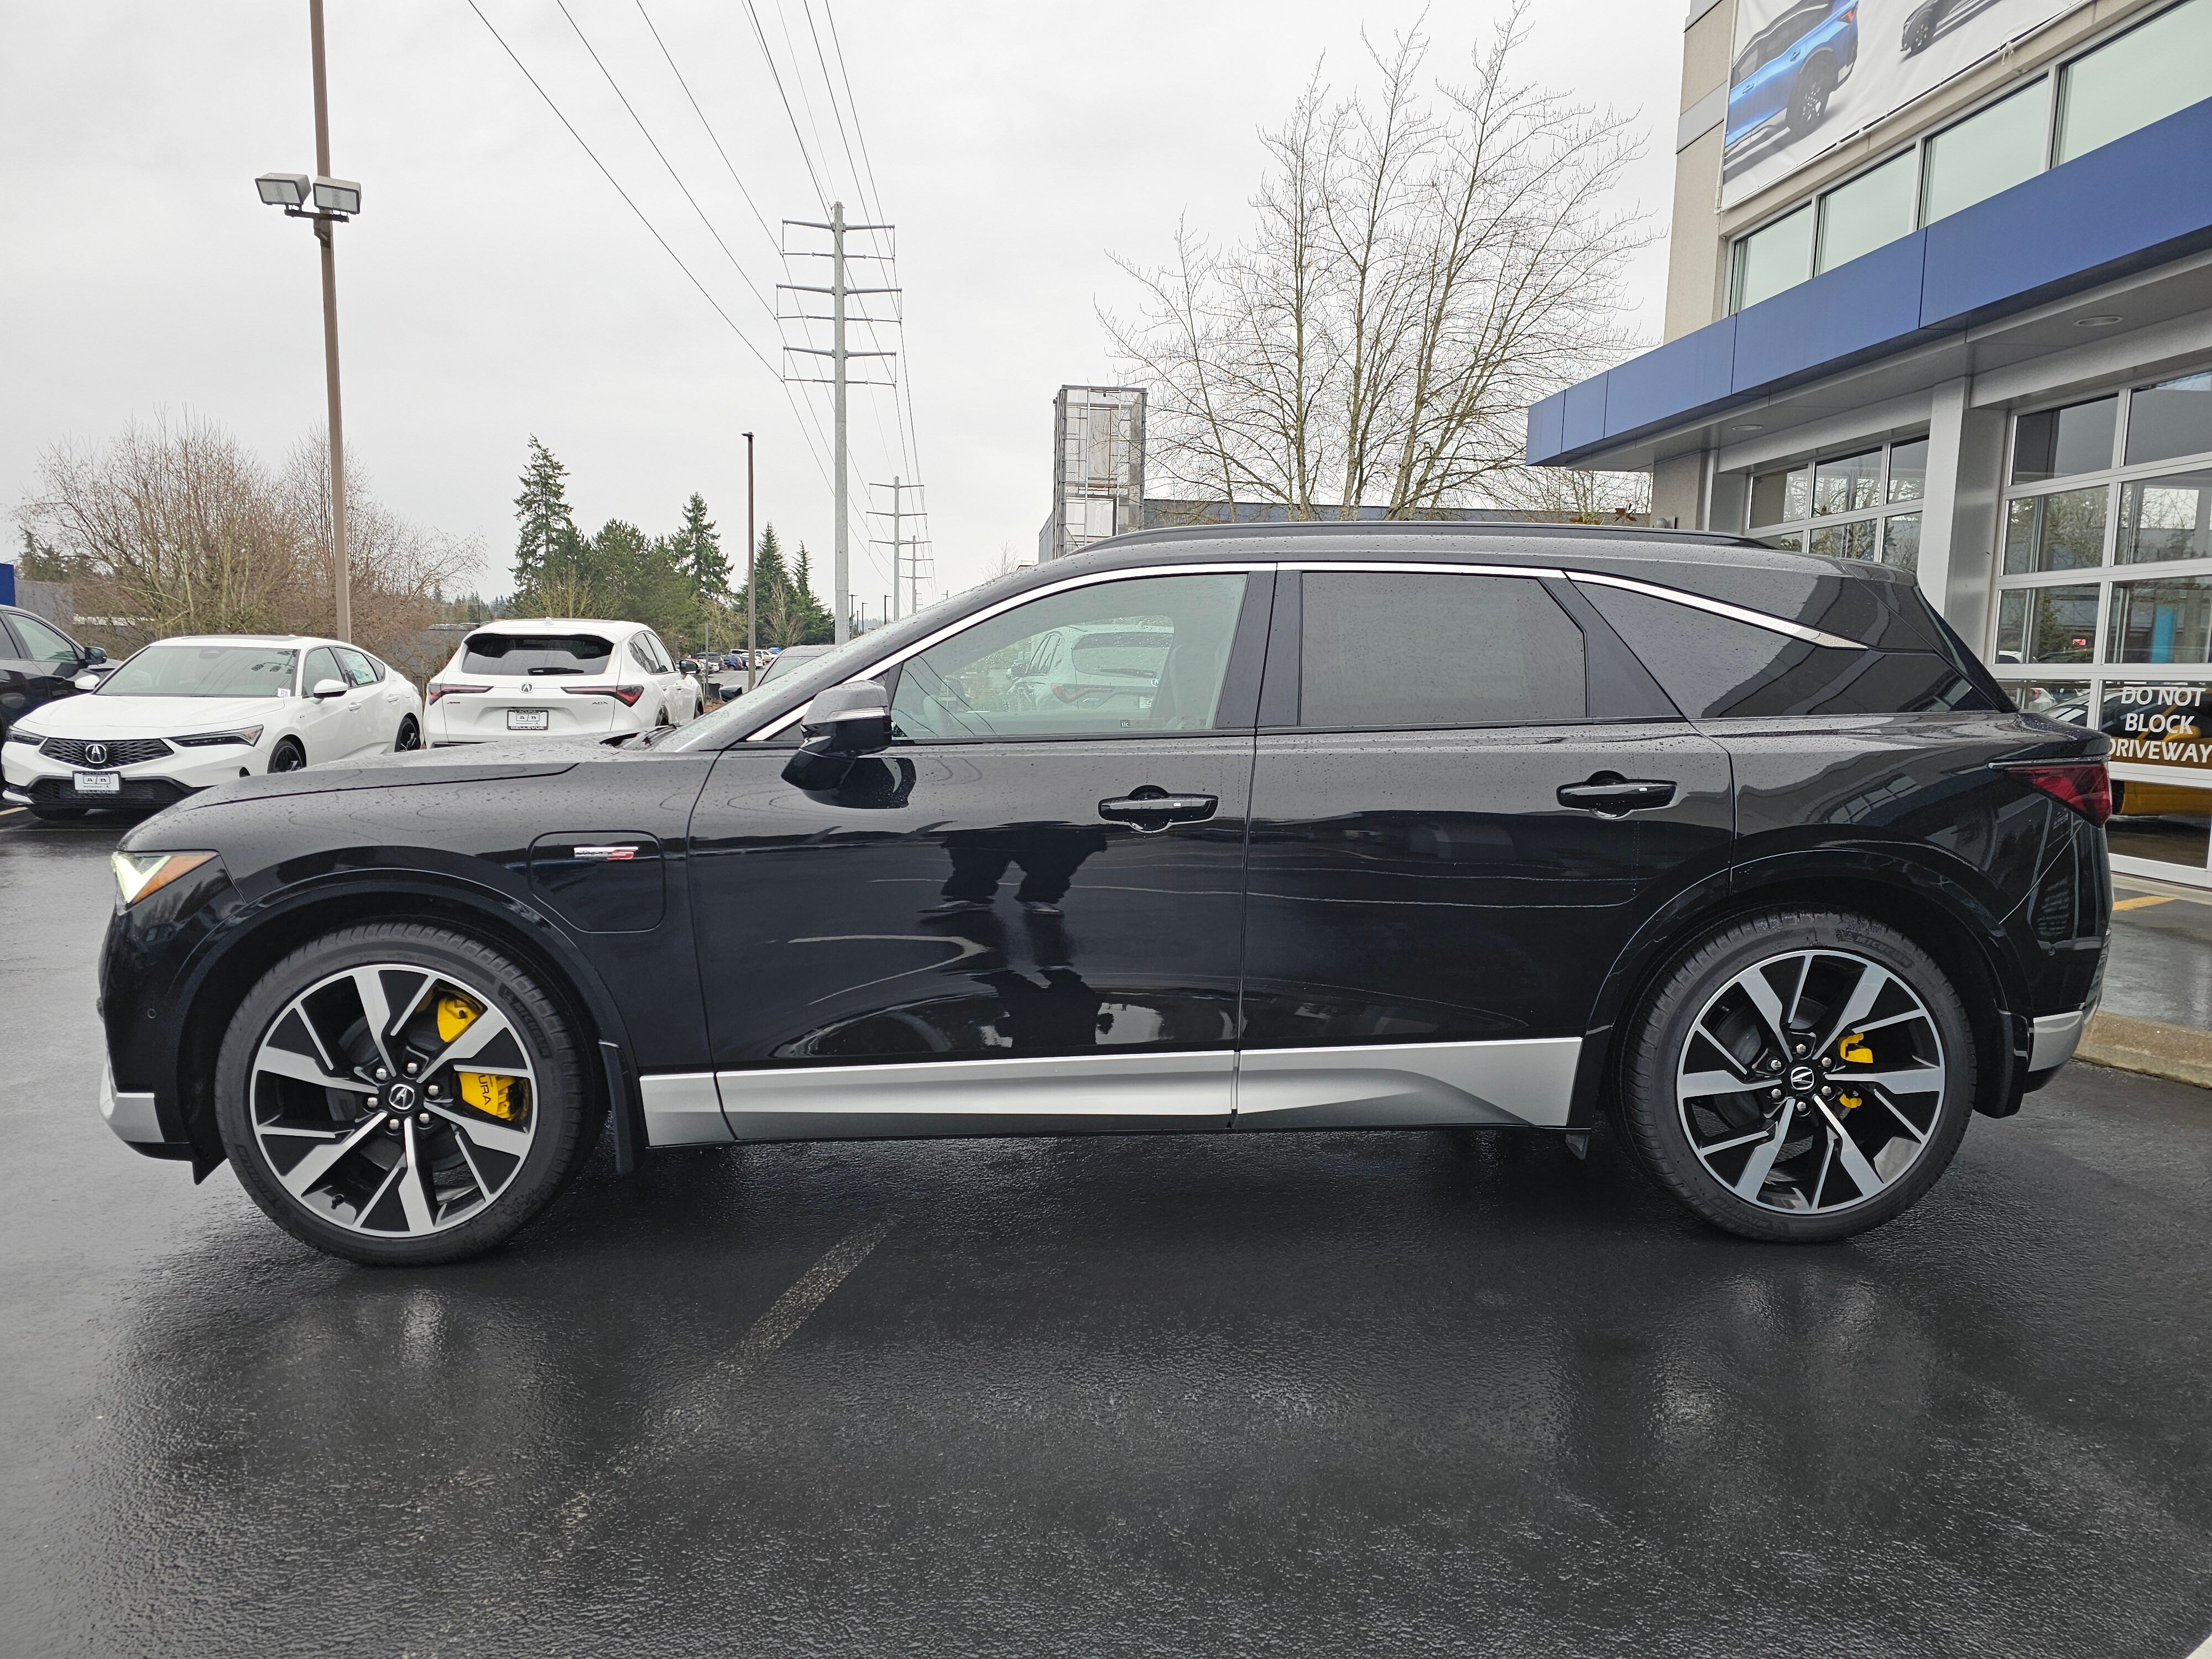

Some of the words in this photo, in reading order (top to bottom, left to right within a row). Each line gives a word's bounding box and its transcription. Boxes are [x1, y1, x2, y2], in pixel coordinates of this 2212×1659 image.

[2121, 686, 2152, 705] DO
[2157, 687, 2206, 707] NOT
[2125, 713, 2195, 735] BLOCK
[478, 1074, 492, 1105] URA
